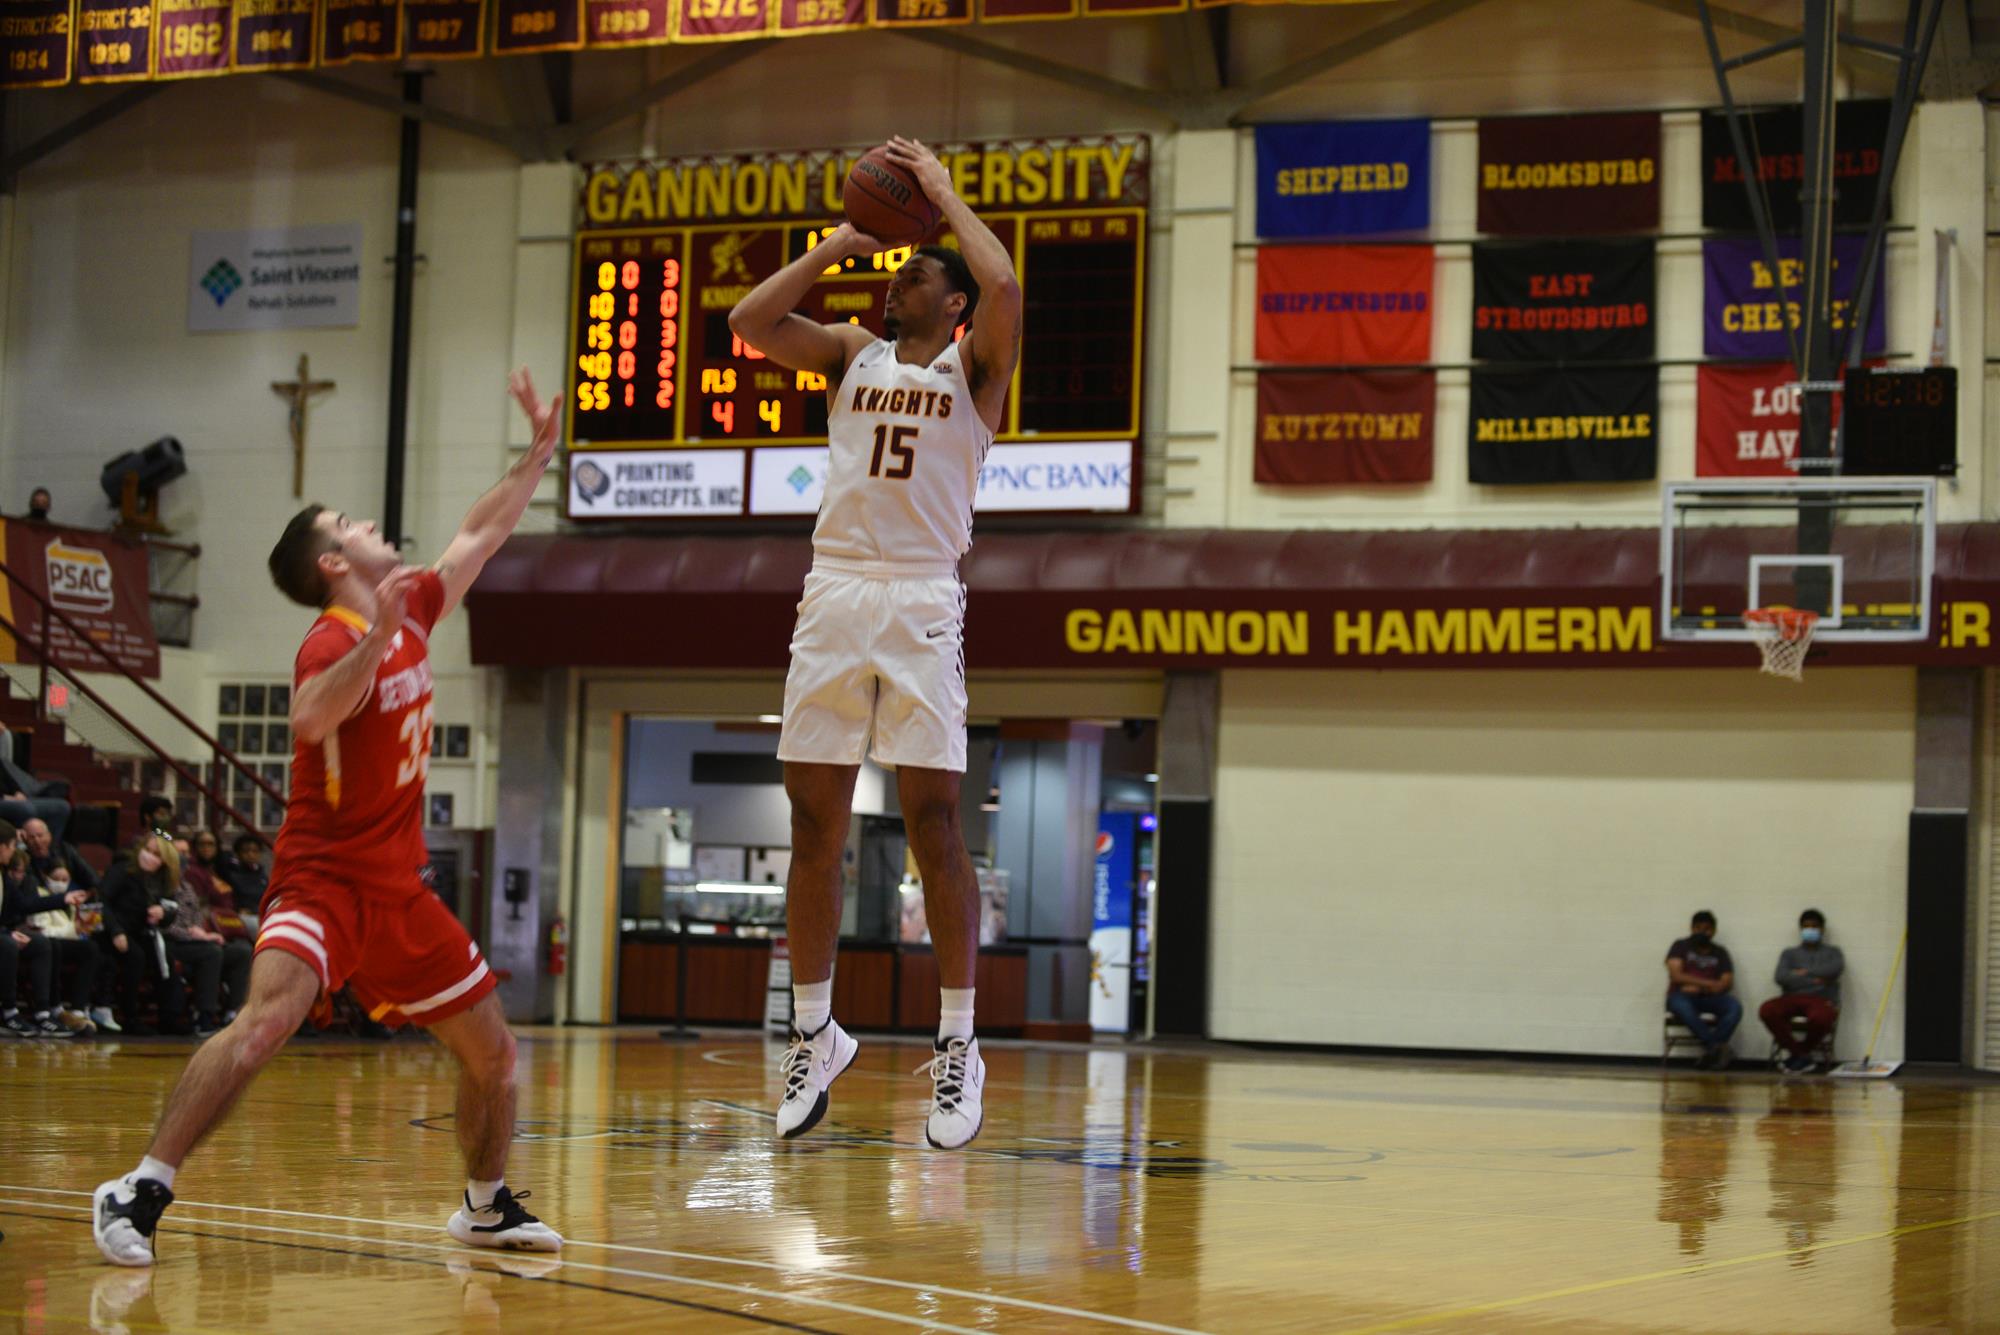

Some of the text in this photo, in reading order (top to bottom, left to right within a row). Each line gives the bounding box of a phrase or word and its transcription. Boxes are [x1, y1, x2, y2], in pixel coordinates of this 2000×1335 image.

[163, 22, 223, 58] 1962
[587, 146, 1134, 222] GANNON UERSITY
[1277, 162, 1409, 196] SHEPHERD
[1483, 157, 1655, 189] BLOOMSBURG
[251, 263, 360, 286] Saint Vincent
[598, 258, 679, 291] 0 0 3
[1529, 273, 1594, 298] EAST
[589, 291, 615, 321] 10
[660, 289, 678, 318] 0
[1476, 302, 1648, 331] STROUDSBURG
[588, 318, 677, 351] 15 0 3
[578, 349, 675, 381] 40 0 2
[656, 379, 674, 409] 2
[852, 386, 953, 419] KNIGHTS
[712, 401, 735, 433] 4
[758, 400, 781, 433] 4
[1263, 411, 1423, 441] KUTZTOWN
[1476, 413, 1651, 442] MILLERSVILLE
[868, 424, 919, 481] 15
[1737, 430, 1799, 460] HAV
[615, 461, 696, 482] PRINTING
[979, 461, 1131, 491] PNC BANK
[50, 561, 110, 593] PSAC
[1065, 606, 1653, 655] GANNON HAMMERM
